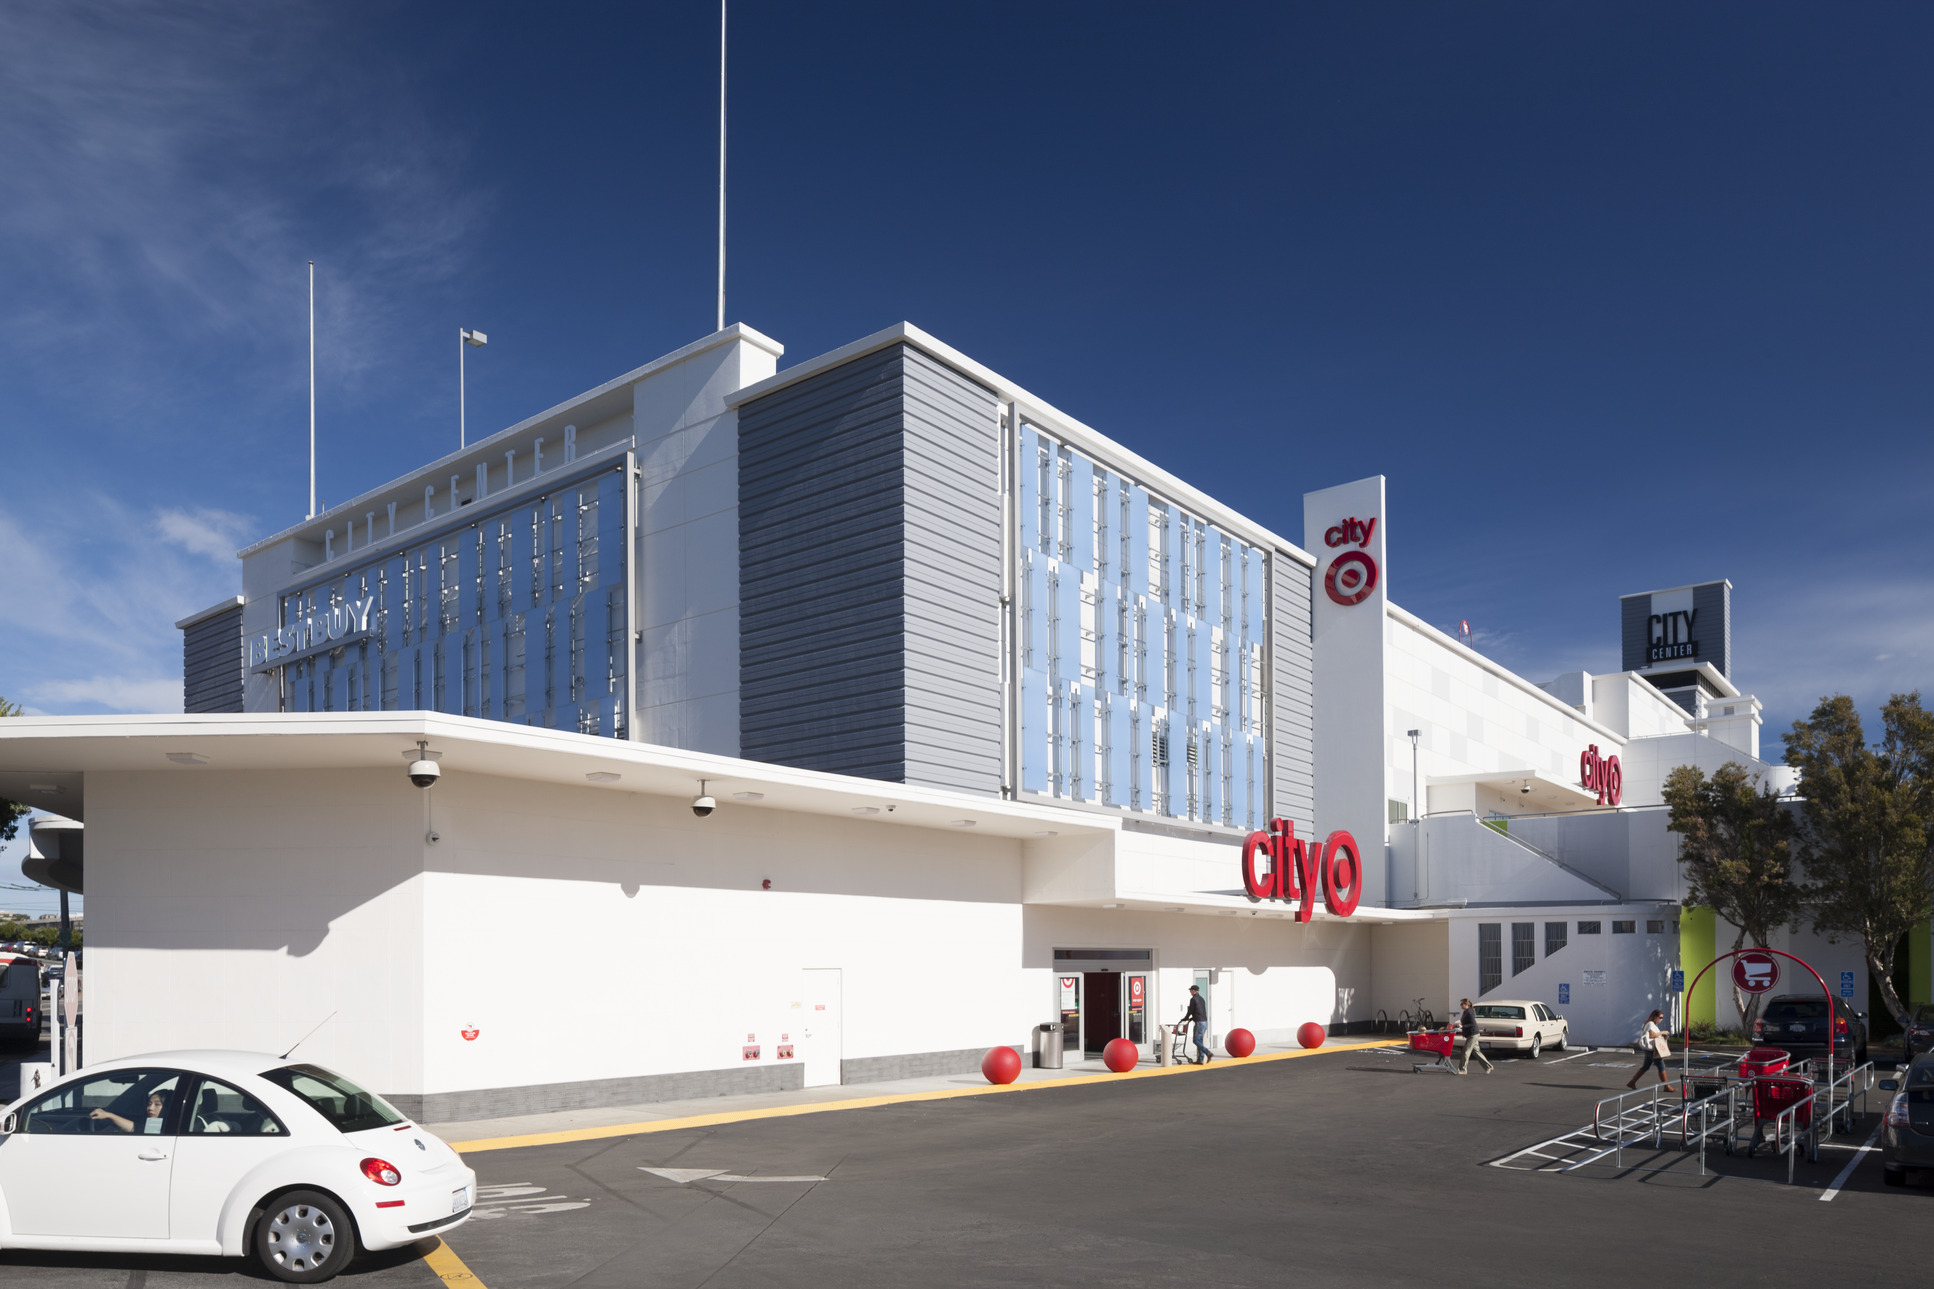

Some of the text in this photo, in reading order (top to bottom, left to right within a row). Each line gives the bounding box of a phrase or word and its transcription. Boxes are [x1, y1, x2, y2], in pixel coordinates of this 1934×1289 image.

[325, 424, 577, 562] CITY CENTER
[1324, 517, 1376, 548] city
[1647, 608, 1698, 646] CITY
[1652, 644, 1692, 660] CENTER
[1241, 817, 1322, 924] city
